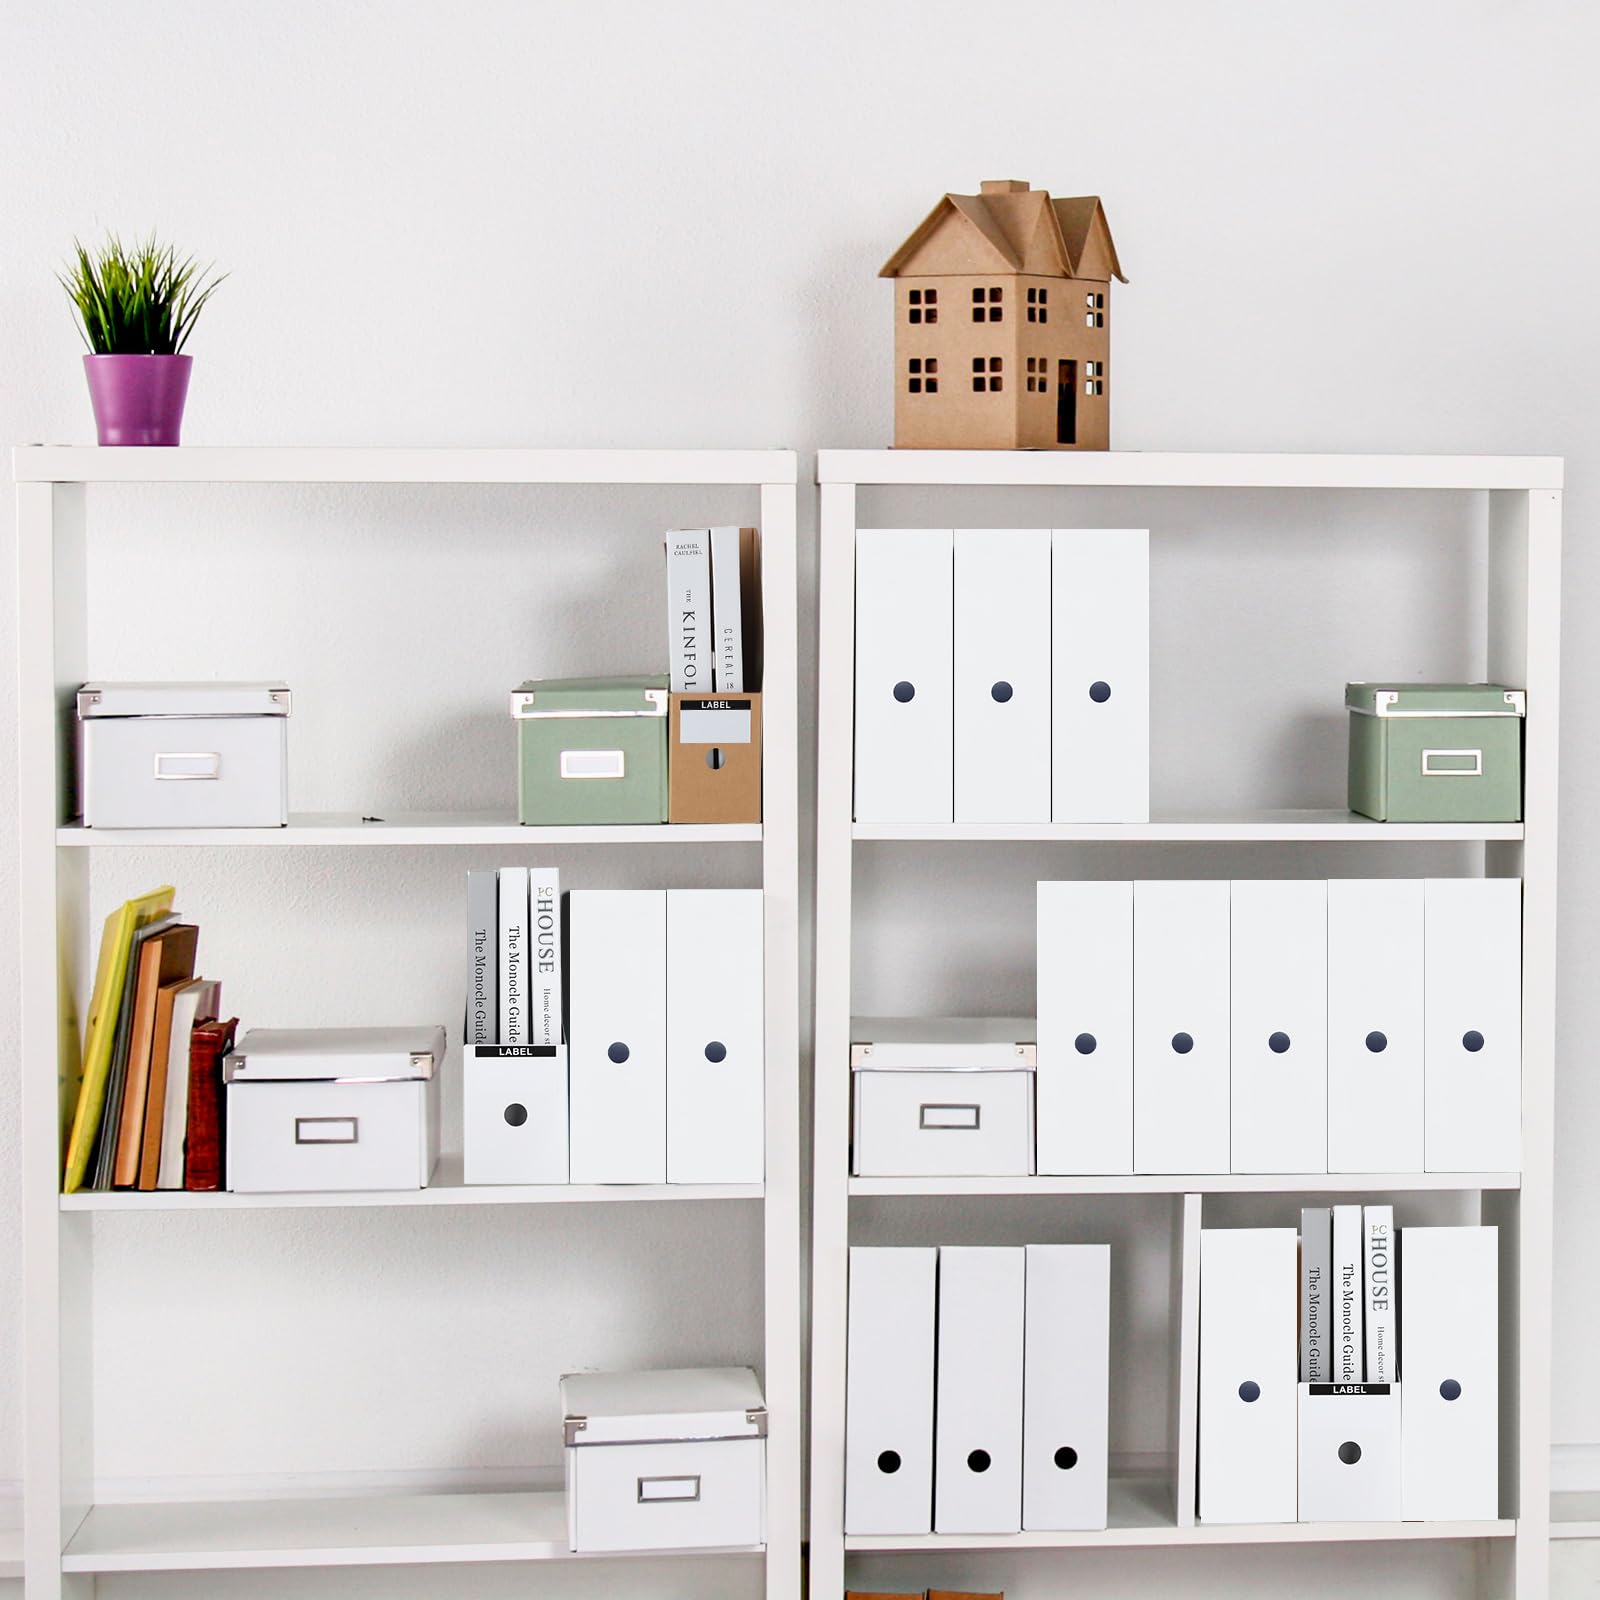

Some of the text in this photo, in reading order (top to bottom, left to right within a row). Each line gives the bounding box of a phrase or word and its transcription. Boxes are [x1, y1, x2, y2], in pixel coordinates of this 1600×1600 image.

[682, 610, 697, 690] KINFOL
[723, 627, 734, 677] CEREAL
[701, 701, 731, 709] LABEL
[474, 929, 486, 953] The
[537, 899, 555, 974] HOUSE
[474, 955, 487, 1008] Monocle
[508, 925, 521, 1043] The Monocle Guide
[543, 1013, 551, 1037] decor
[499, 1047, 533, 1056] LABEL
[1308, 1267, 1320, 1291] The
[1371, 1236, 1388, 1312] HOUSE
[1308, 1294, 1320, 1346] Monocle
[1342, 1263, 1355, 1381] The Monocle Guide
[1377, 1351, 1385, 1374] decor
[1333, 1385, 1367, 1394] LABEL
